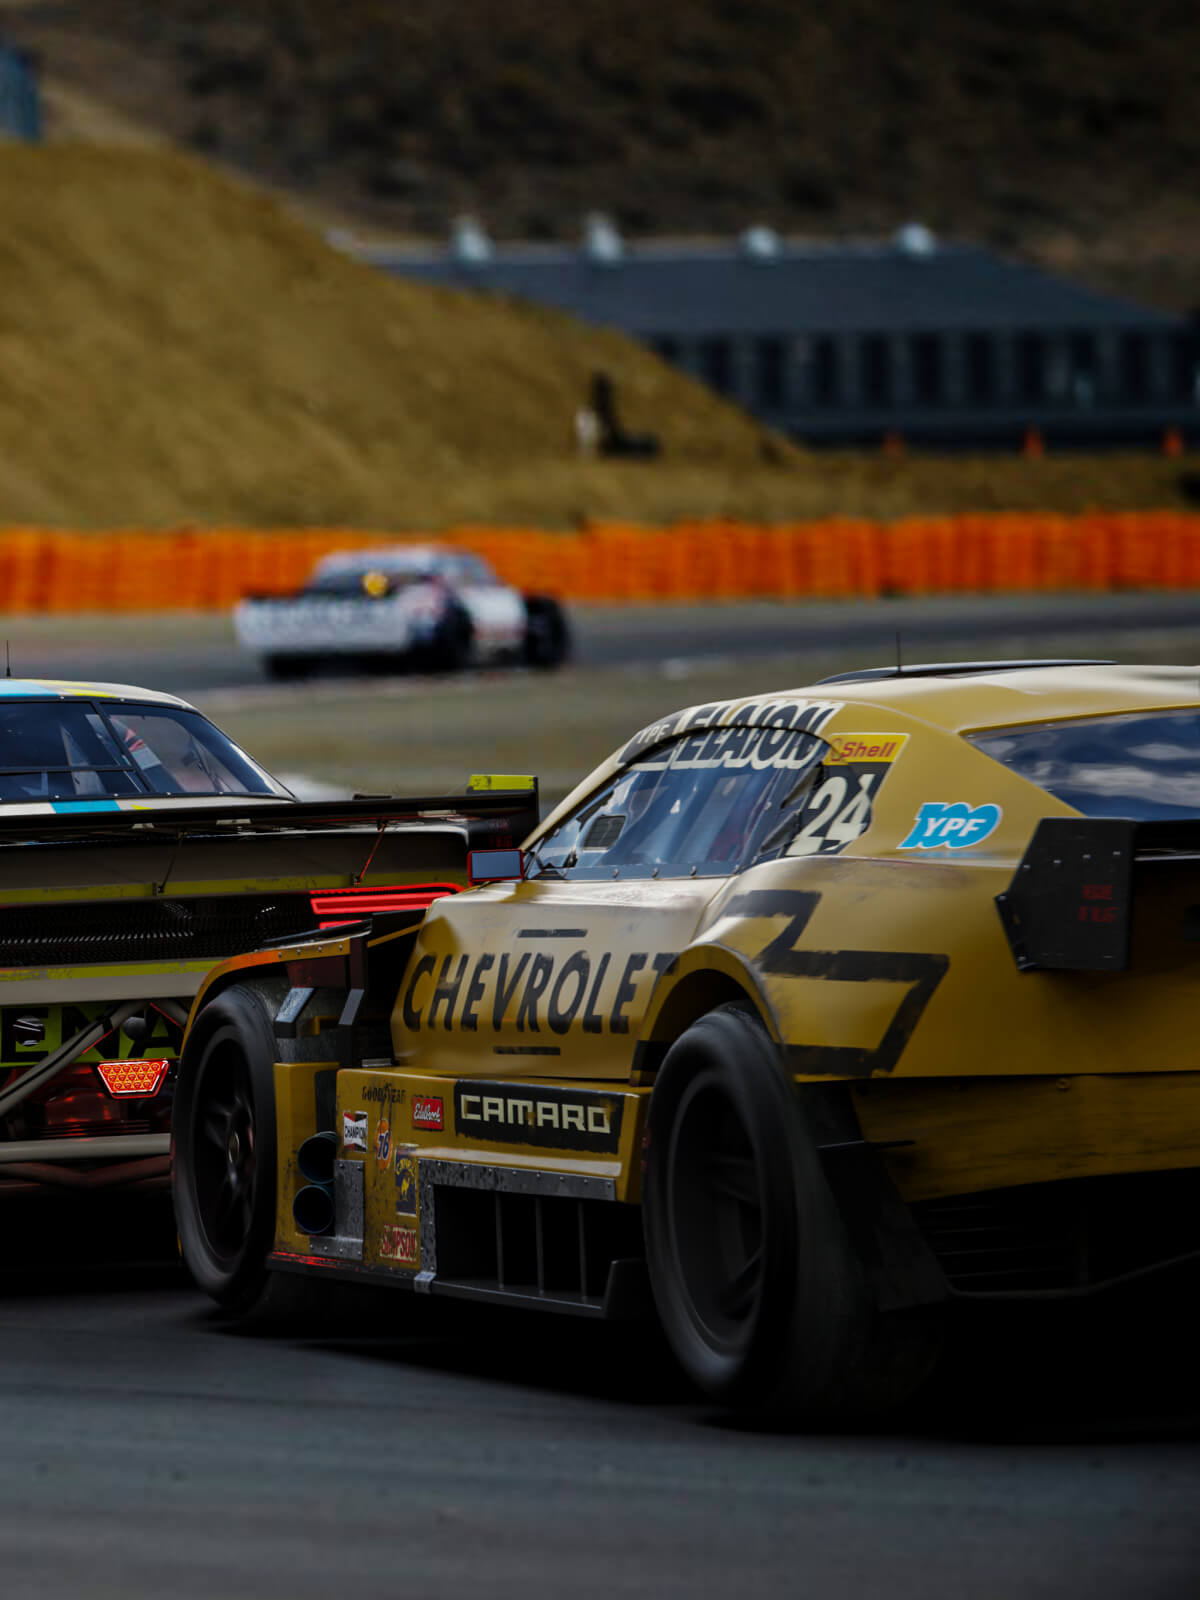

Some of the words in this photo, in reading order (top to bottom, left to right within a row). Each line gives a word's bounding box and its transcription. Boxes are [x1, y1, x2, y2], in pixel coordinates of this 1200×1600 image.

[669, 700, 847, 770] ELAION
[842, 741, 897, 758] Shell
[785, 773, 874, 856] 24
[923, 817, 987, 837] YPF
[460, 1094, 611, 1134] CAMARO
[377, 1131, 390, 1160] 76
